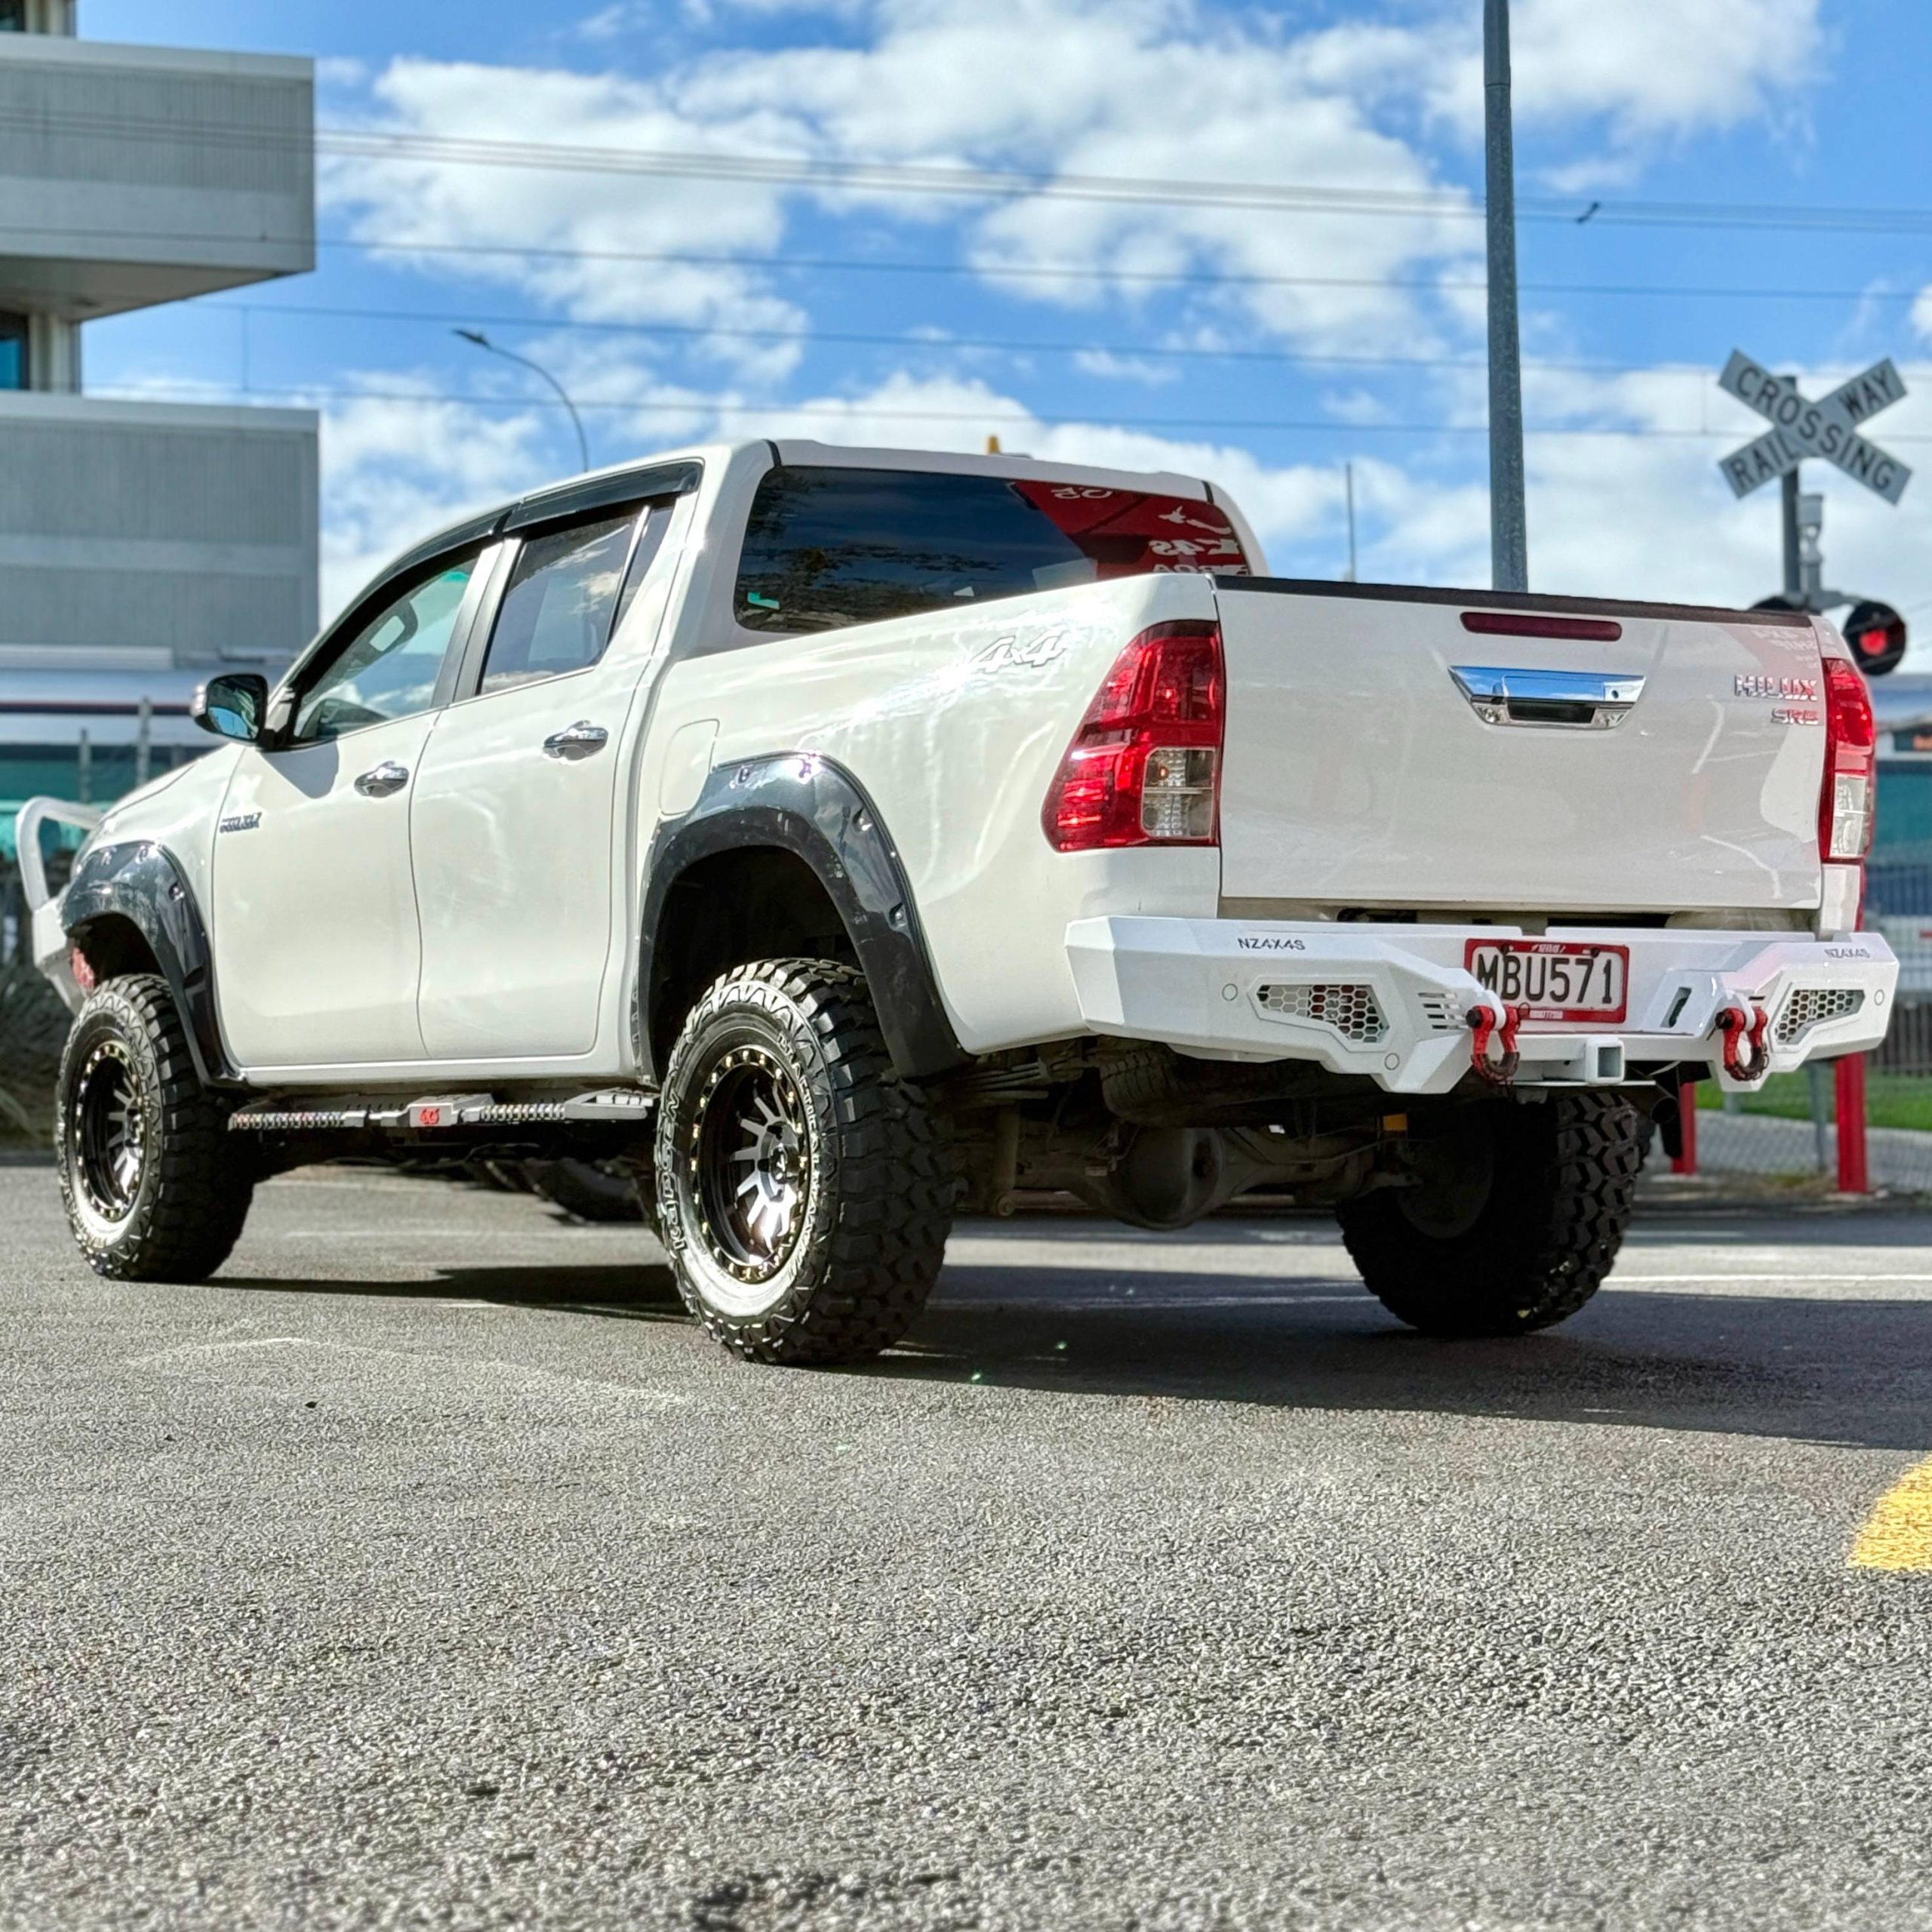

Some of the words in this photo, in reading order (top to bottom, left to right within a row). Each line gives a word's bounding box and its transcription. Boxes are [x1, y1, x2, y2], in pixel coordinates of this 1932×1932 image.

[1727, 430, 1799, 488] RAIL
[1839, 365, 1892, 420] WAY
[1737, 366, 1896, 491] CROSSING
[1735, 675, 1818, 701] HILUX
[1476, 953, 1613, 1004] MBU571
